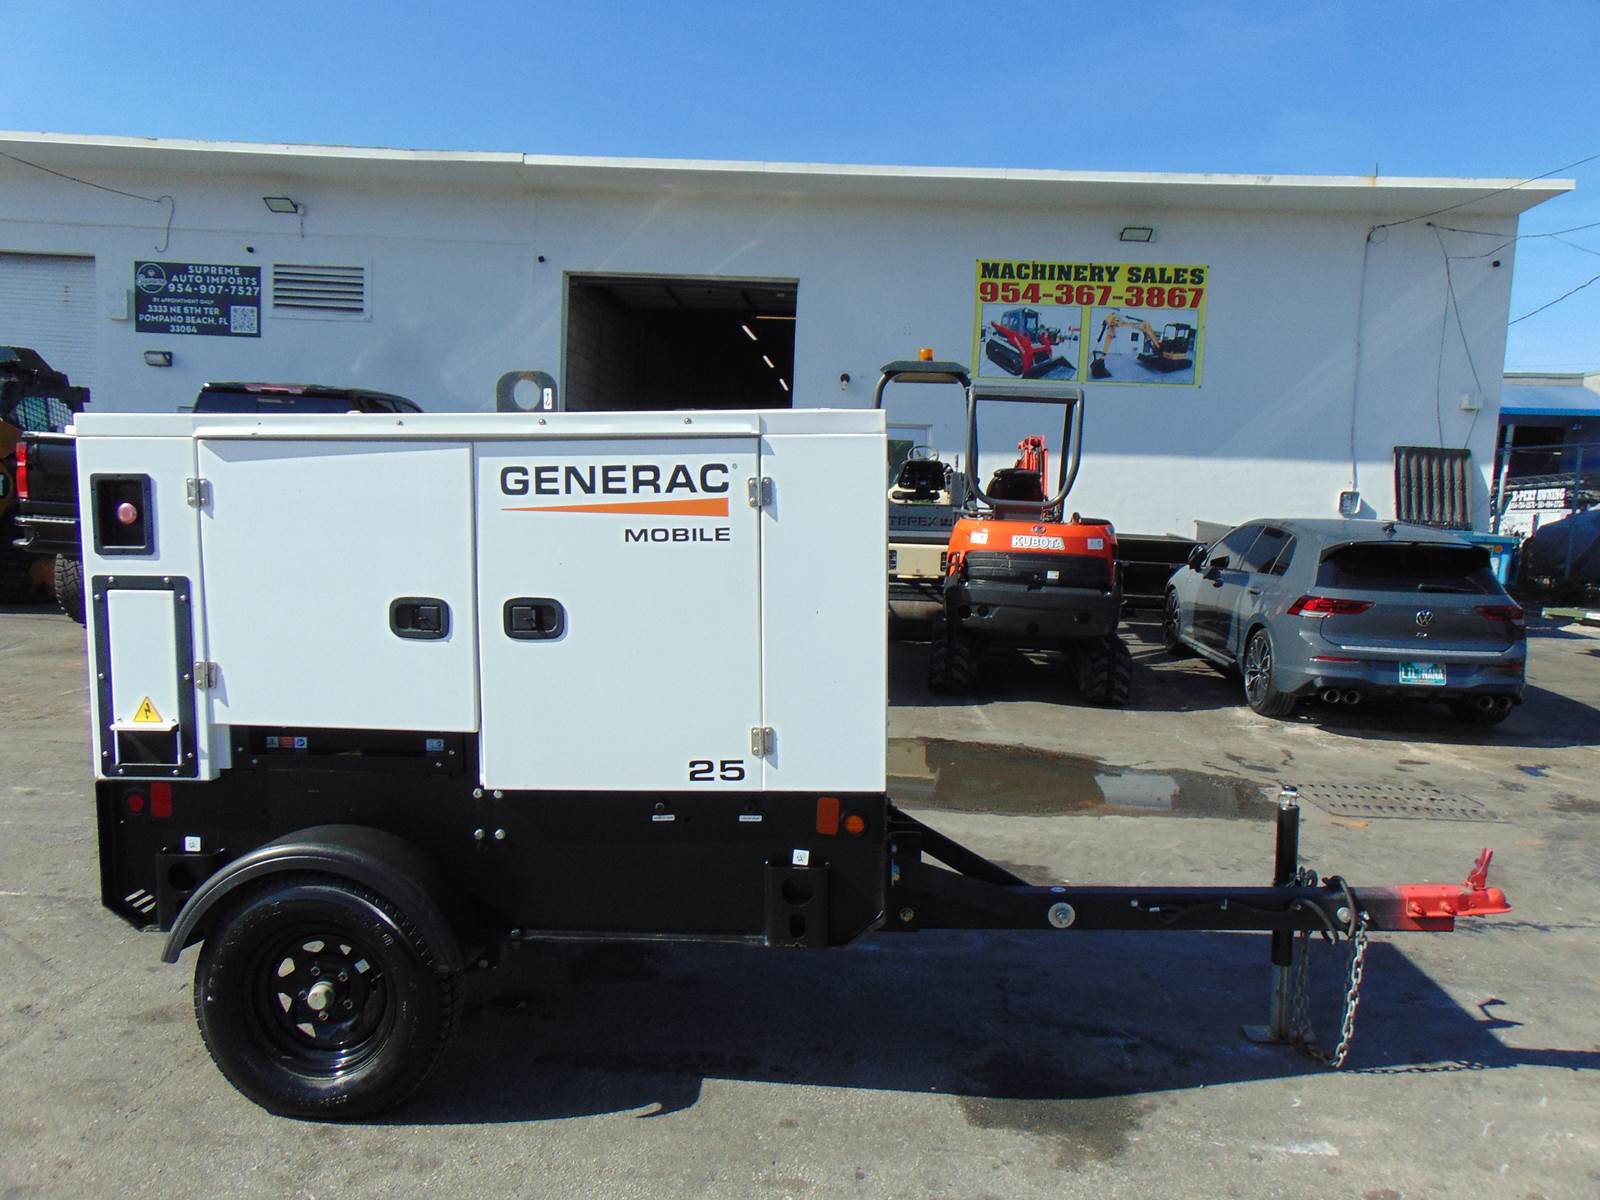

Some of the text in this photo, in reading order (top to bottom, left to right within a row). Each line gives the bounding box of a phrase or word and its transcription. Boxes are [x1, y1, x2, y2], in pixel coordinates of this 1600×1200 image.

[188, 265, 240, 276] SUPREME
[981, 262, 1204, 285] MACHINERY SALES
[171, 274, 203, 284] AUTO
[206, 275, 257, 286] IMPORTS
[168, 283, 260, 296] 954-907-7527
[979, 281, 1205, 309] 954-367-3867
[147, 304, 220, 315] 3333 NE 6TH TER
[139, 313, 228, 326] POMPANO BEACH, FL
[169, 324, 198, 333] 33064
[500, 463, 729, 496] GENERAC
[624, 527, 731, 543] MOBILE
[1012, 536, 1064, 549] KUBOTA
[688, 759, 746, 782] 25
